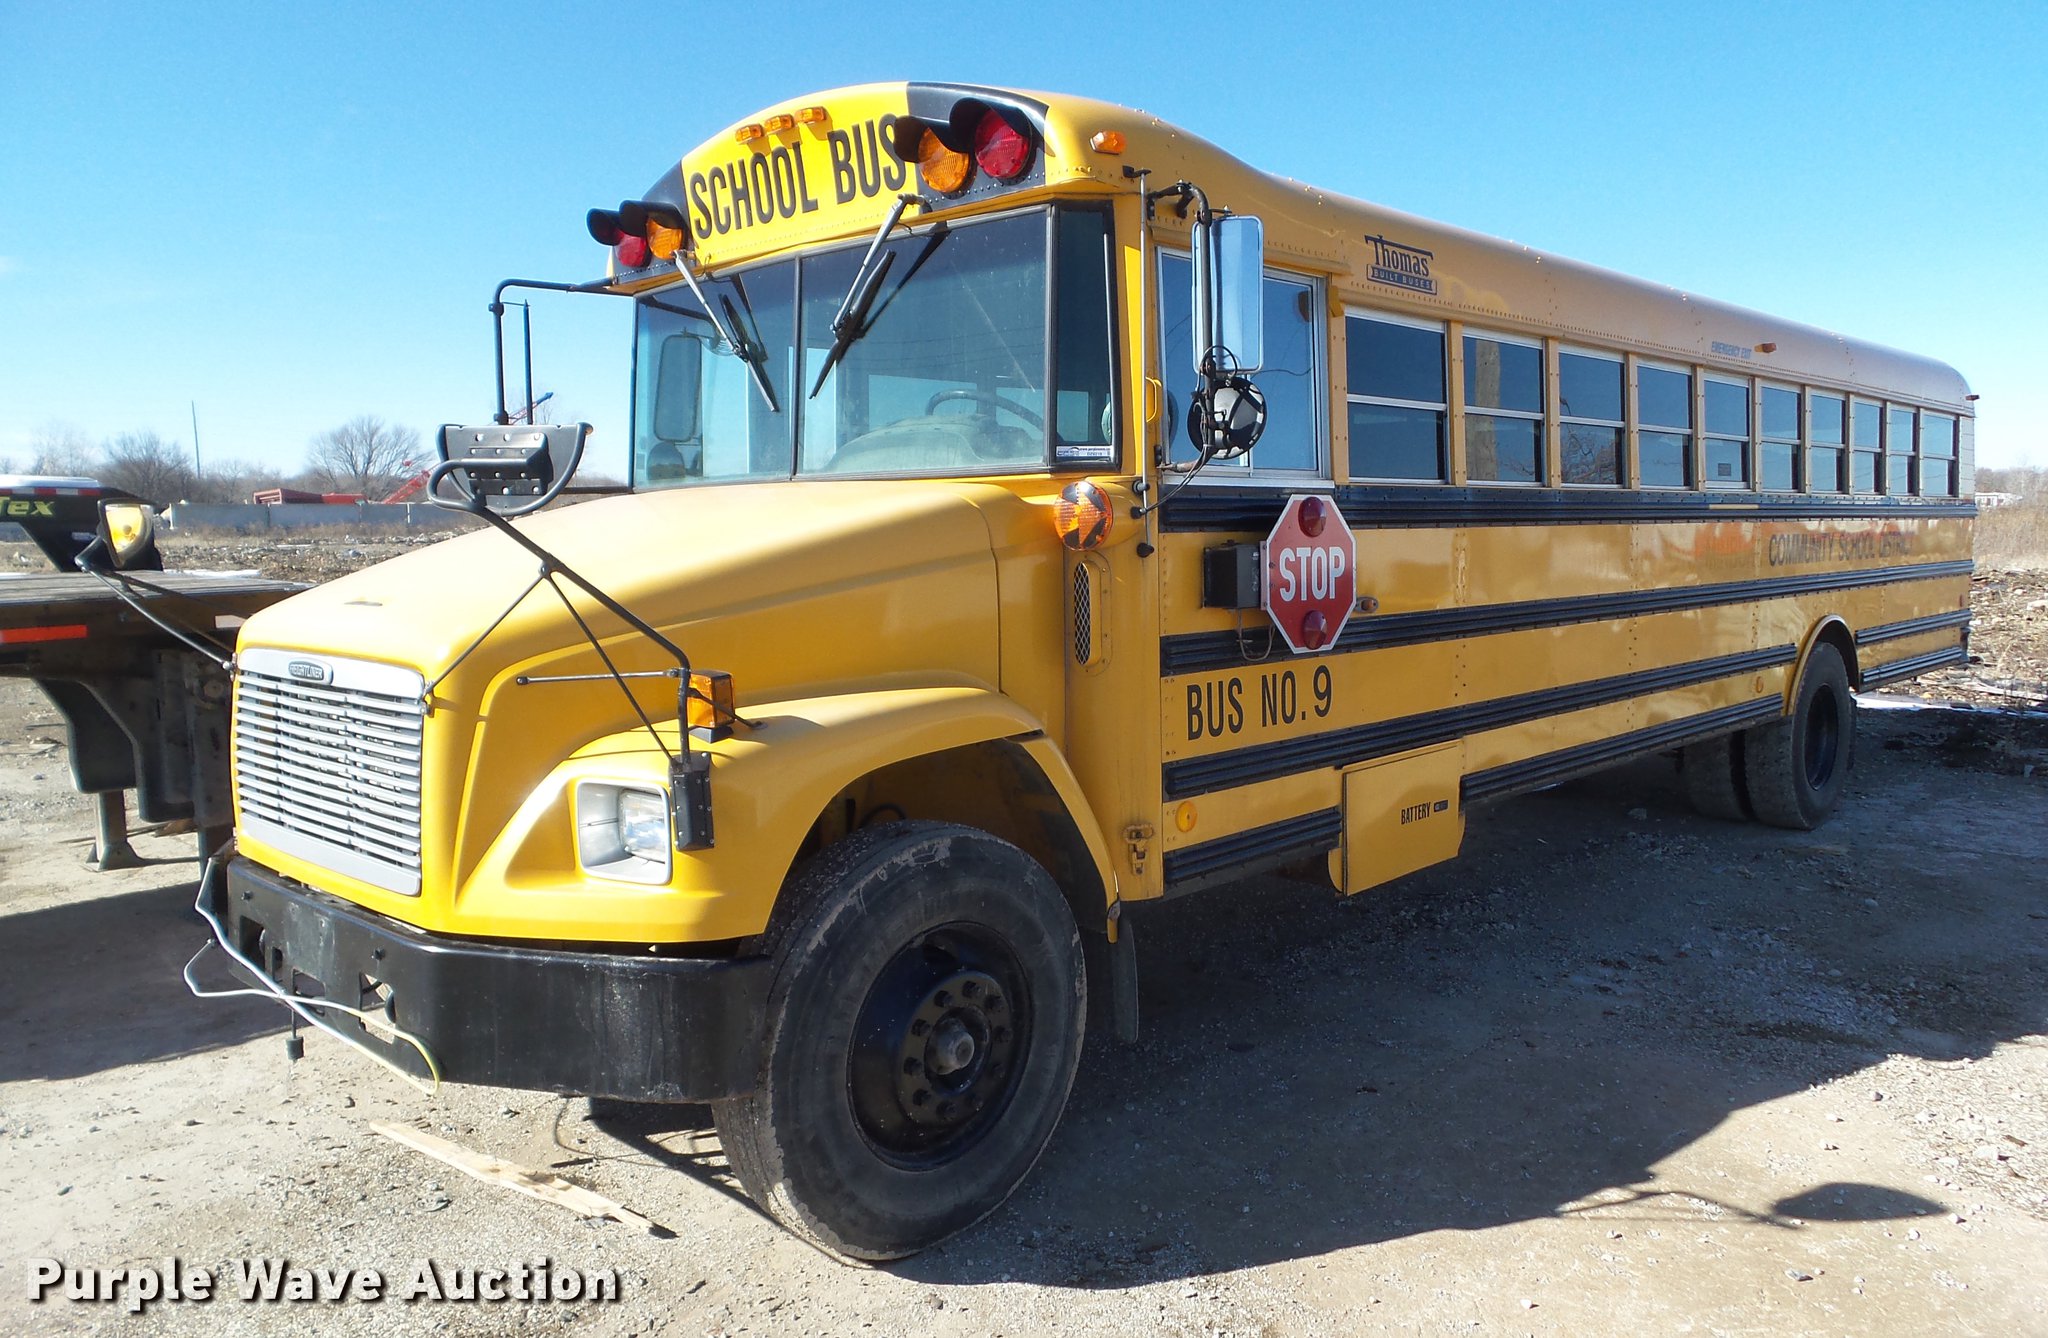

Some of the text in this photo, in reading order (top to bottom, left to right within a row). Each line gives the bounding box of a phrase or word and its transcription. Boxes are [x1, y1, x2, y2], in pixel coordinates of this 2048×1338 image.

[690, 113, 906, 239] SCHOOL BUS
[1364, 234, 1434, 277] Thomas
[1373, 268, 1431, 289] BUILT BUSES
[1711, 341, 1752, 359] EMERGENCY EXIT
[1769, 532, 1835, 566] COMMUNITY
[1838, 530, 1875, 561] SCHOOL
[1279, 546, 1345, 602] STOP
[1187, 665, 1332, 741] BUS NO. 9
[1401, 802, 1431, 825] BATTERY
